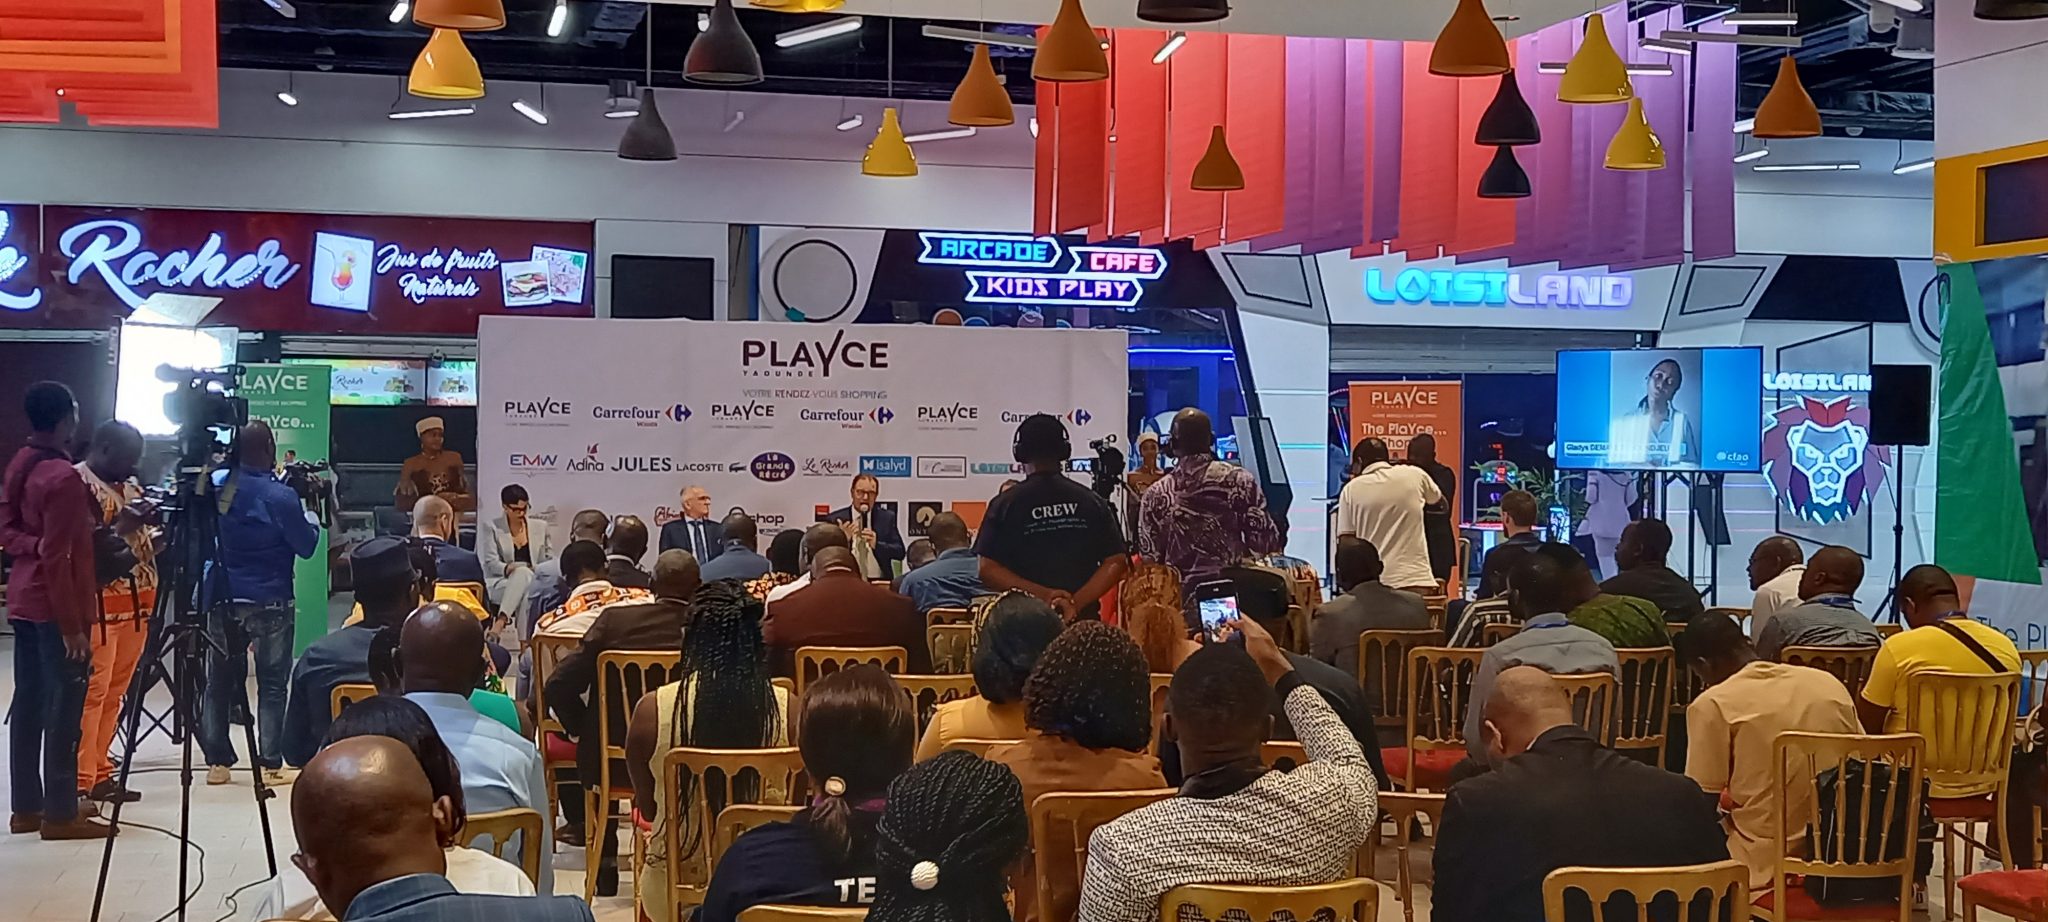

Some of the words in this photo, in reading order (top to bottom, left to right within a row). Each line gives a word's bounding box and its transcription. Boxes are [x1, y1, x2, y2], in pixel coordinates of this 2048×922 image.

[376, 244, 418, 274] Jus
[420, 247, 444, 269] de
[443, 248, 499, 275] fruits
[941, 239, 1048, 262] ARCADE
[59, 219, 301, 310] Rocher
[1090, 252, 1155, 273] CAFE
[398, 273, 480, 304] Naturels
[986, 276, 1048, 298] KIDS
[1059, 279, 1130, 299] PLAY
[1366, 267, 1633, 309] LOISILAND
[742, 329, 888, 377] PLAYCE
[1762, 372, 1872, 391] LOISILAN
[504, 396, 571, 418] PLAYCE
[1371, 386, 1438, 409] PLAYCE
[592, 406, 660, 420] Carrefour
[711, 400, 775, 420] PLAYCE
[800, 408, 864, 422] Carrefour
[917, 402, 978, 422] PLAYCE
[1362, 423, 1384, 435] The
[510, 454, 558, 466] EMW
[566, 457, 604, 472] Adina
[611, 457, 671, 472] JULES
[1727, 452, 1749, 461] cfao
[676, 463, 723, 472] LACOSTE
[1031, 503, 1078, 519] CREW
[2027, 623, 2048, 650] Pl
[834, 877, 876, 903] TE
